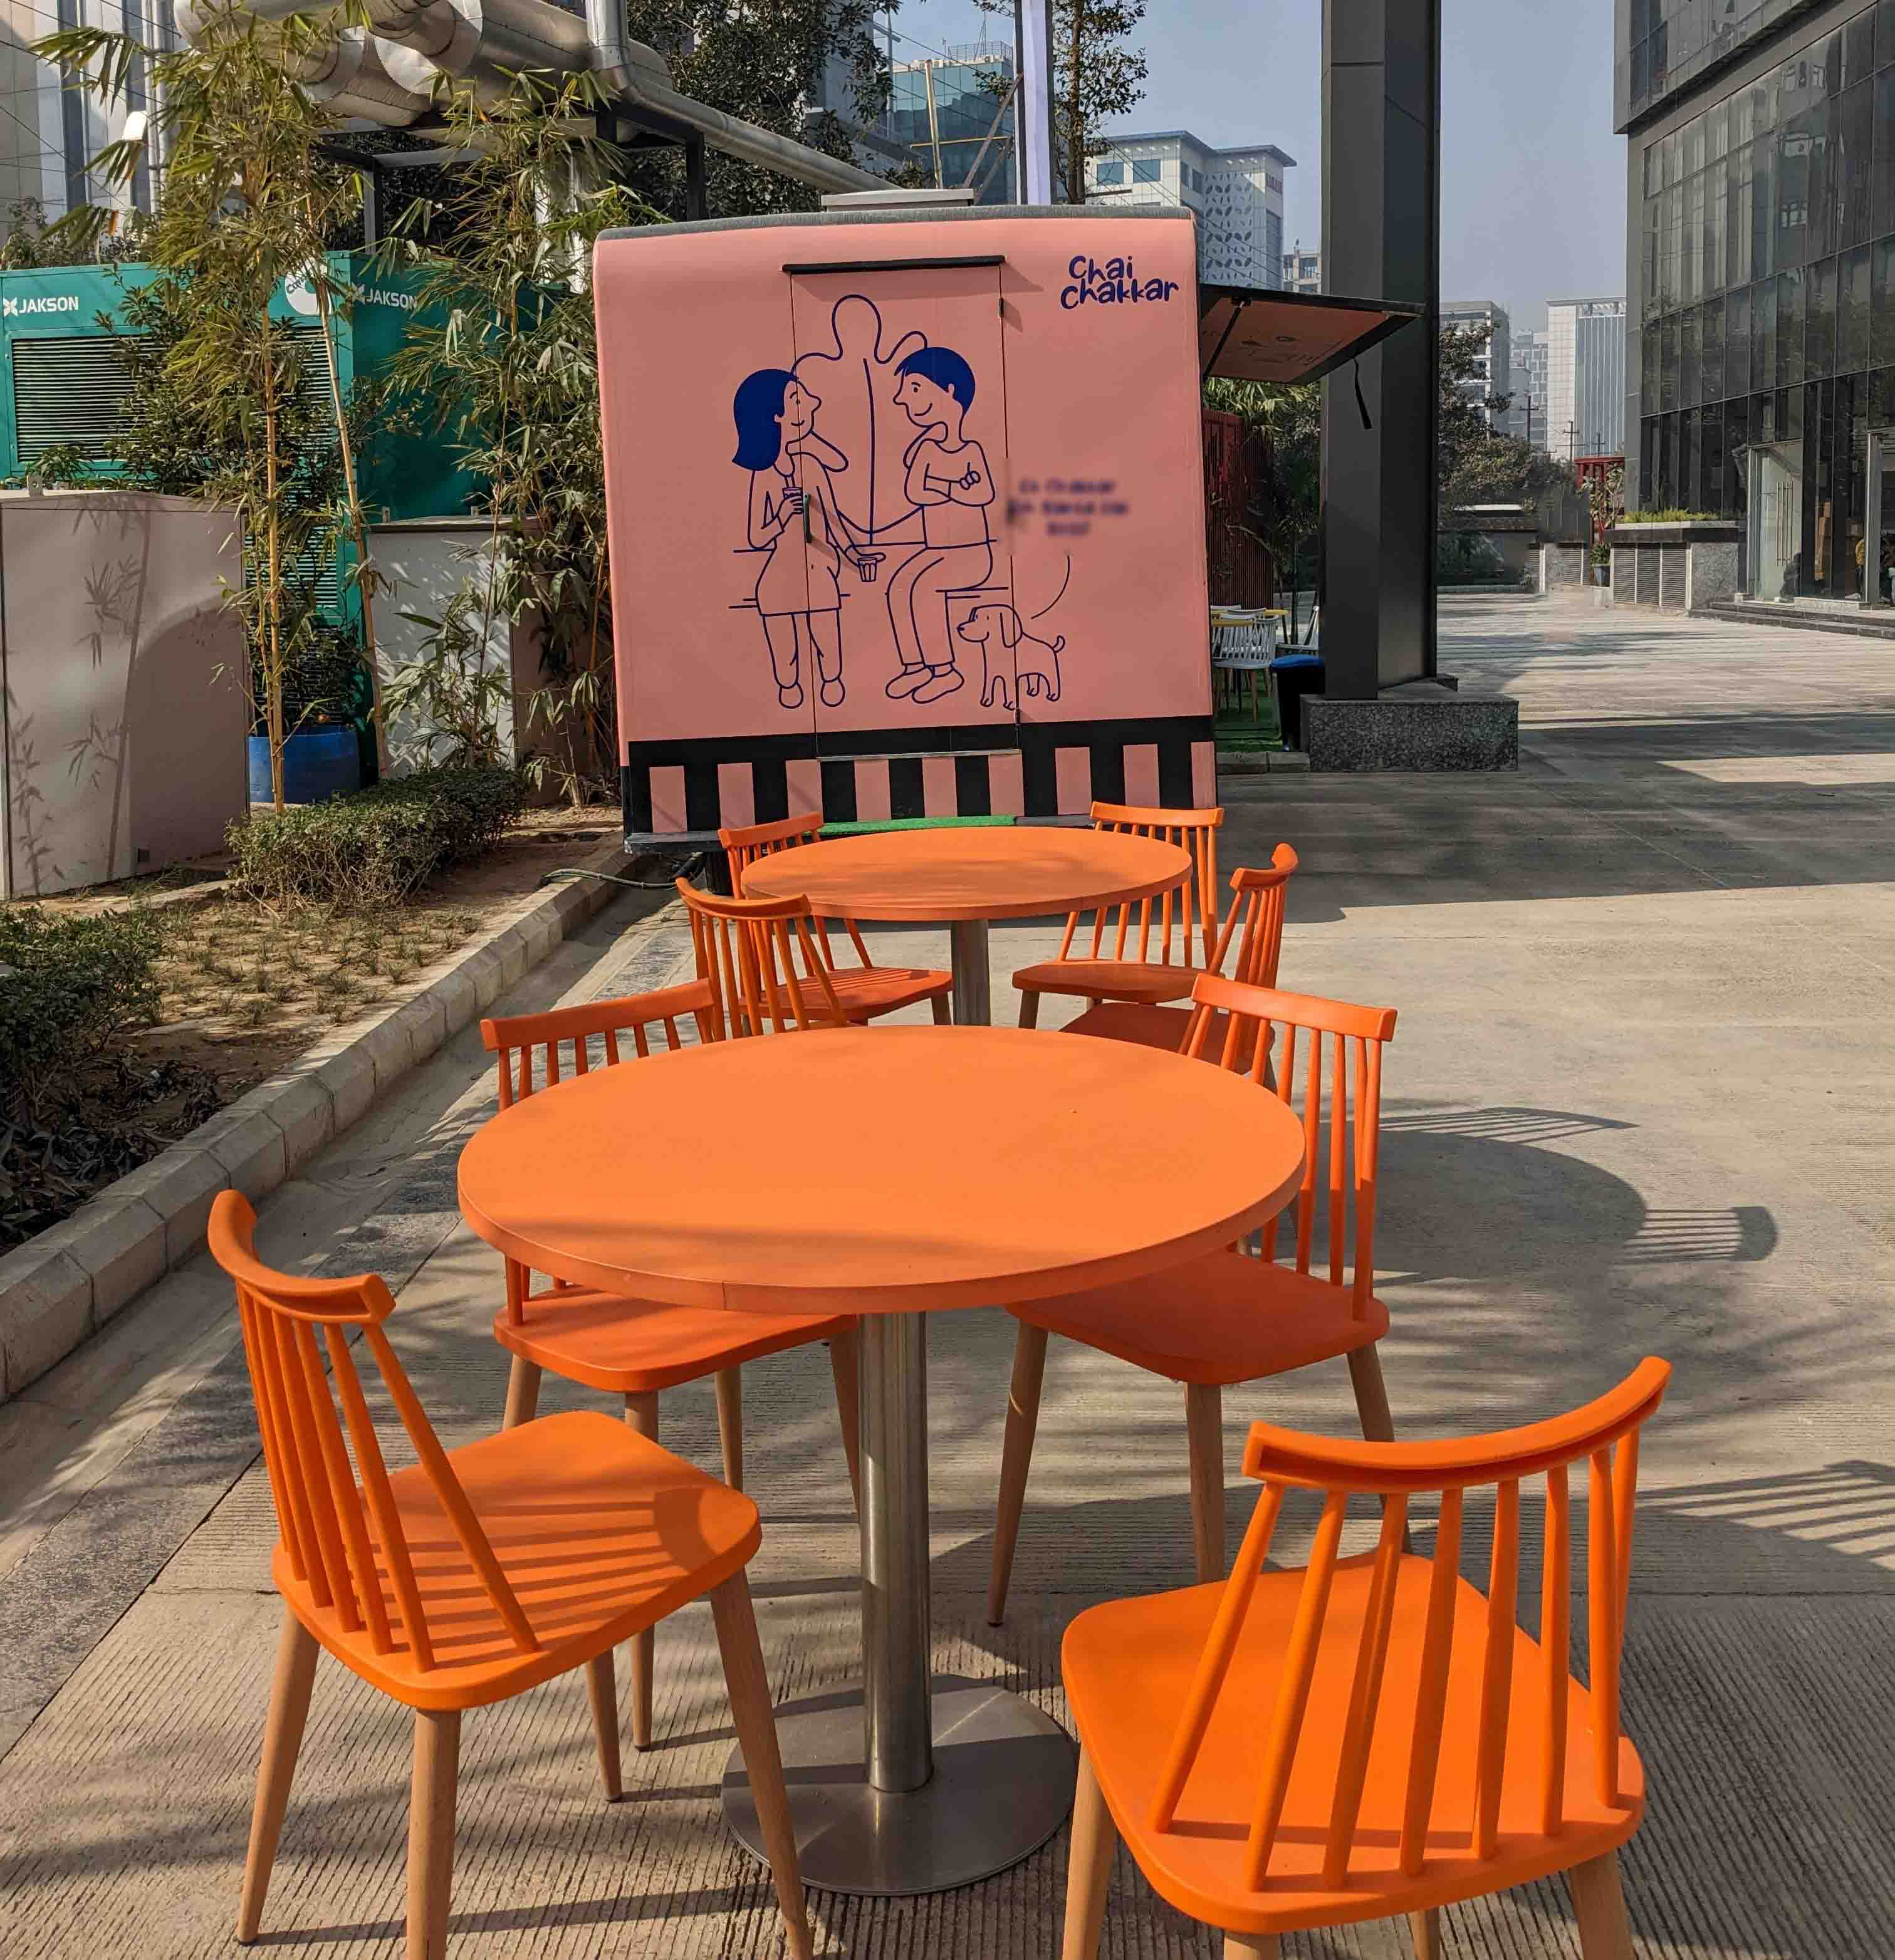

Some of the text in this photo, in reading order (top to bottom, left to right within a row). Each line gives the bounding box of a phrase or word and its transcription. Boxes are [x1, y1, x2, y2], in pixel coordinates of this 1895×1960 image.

[1068, 255, 1133, 284] Chai
[19, 296, 79, 313] JAKSON
[366, 288, 417, 309] JAKSON
